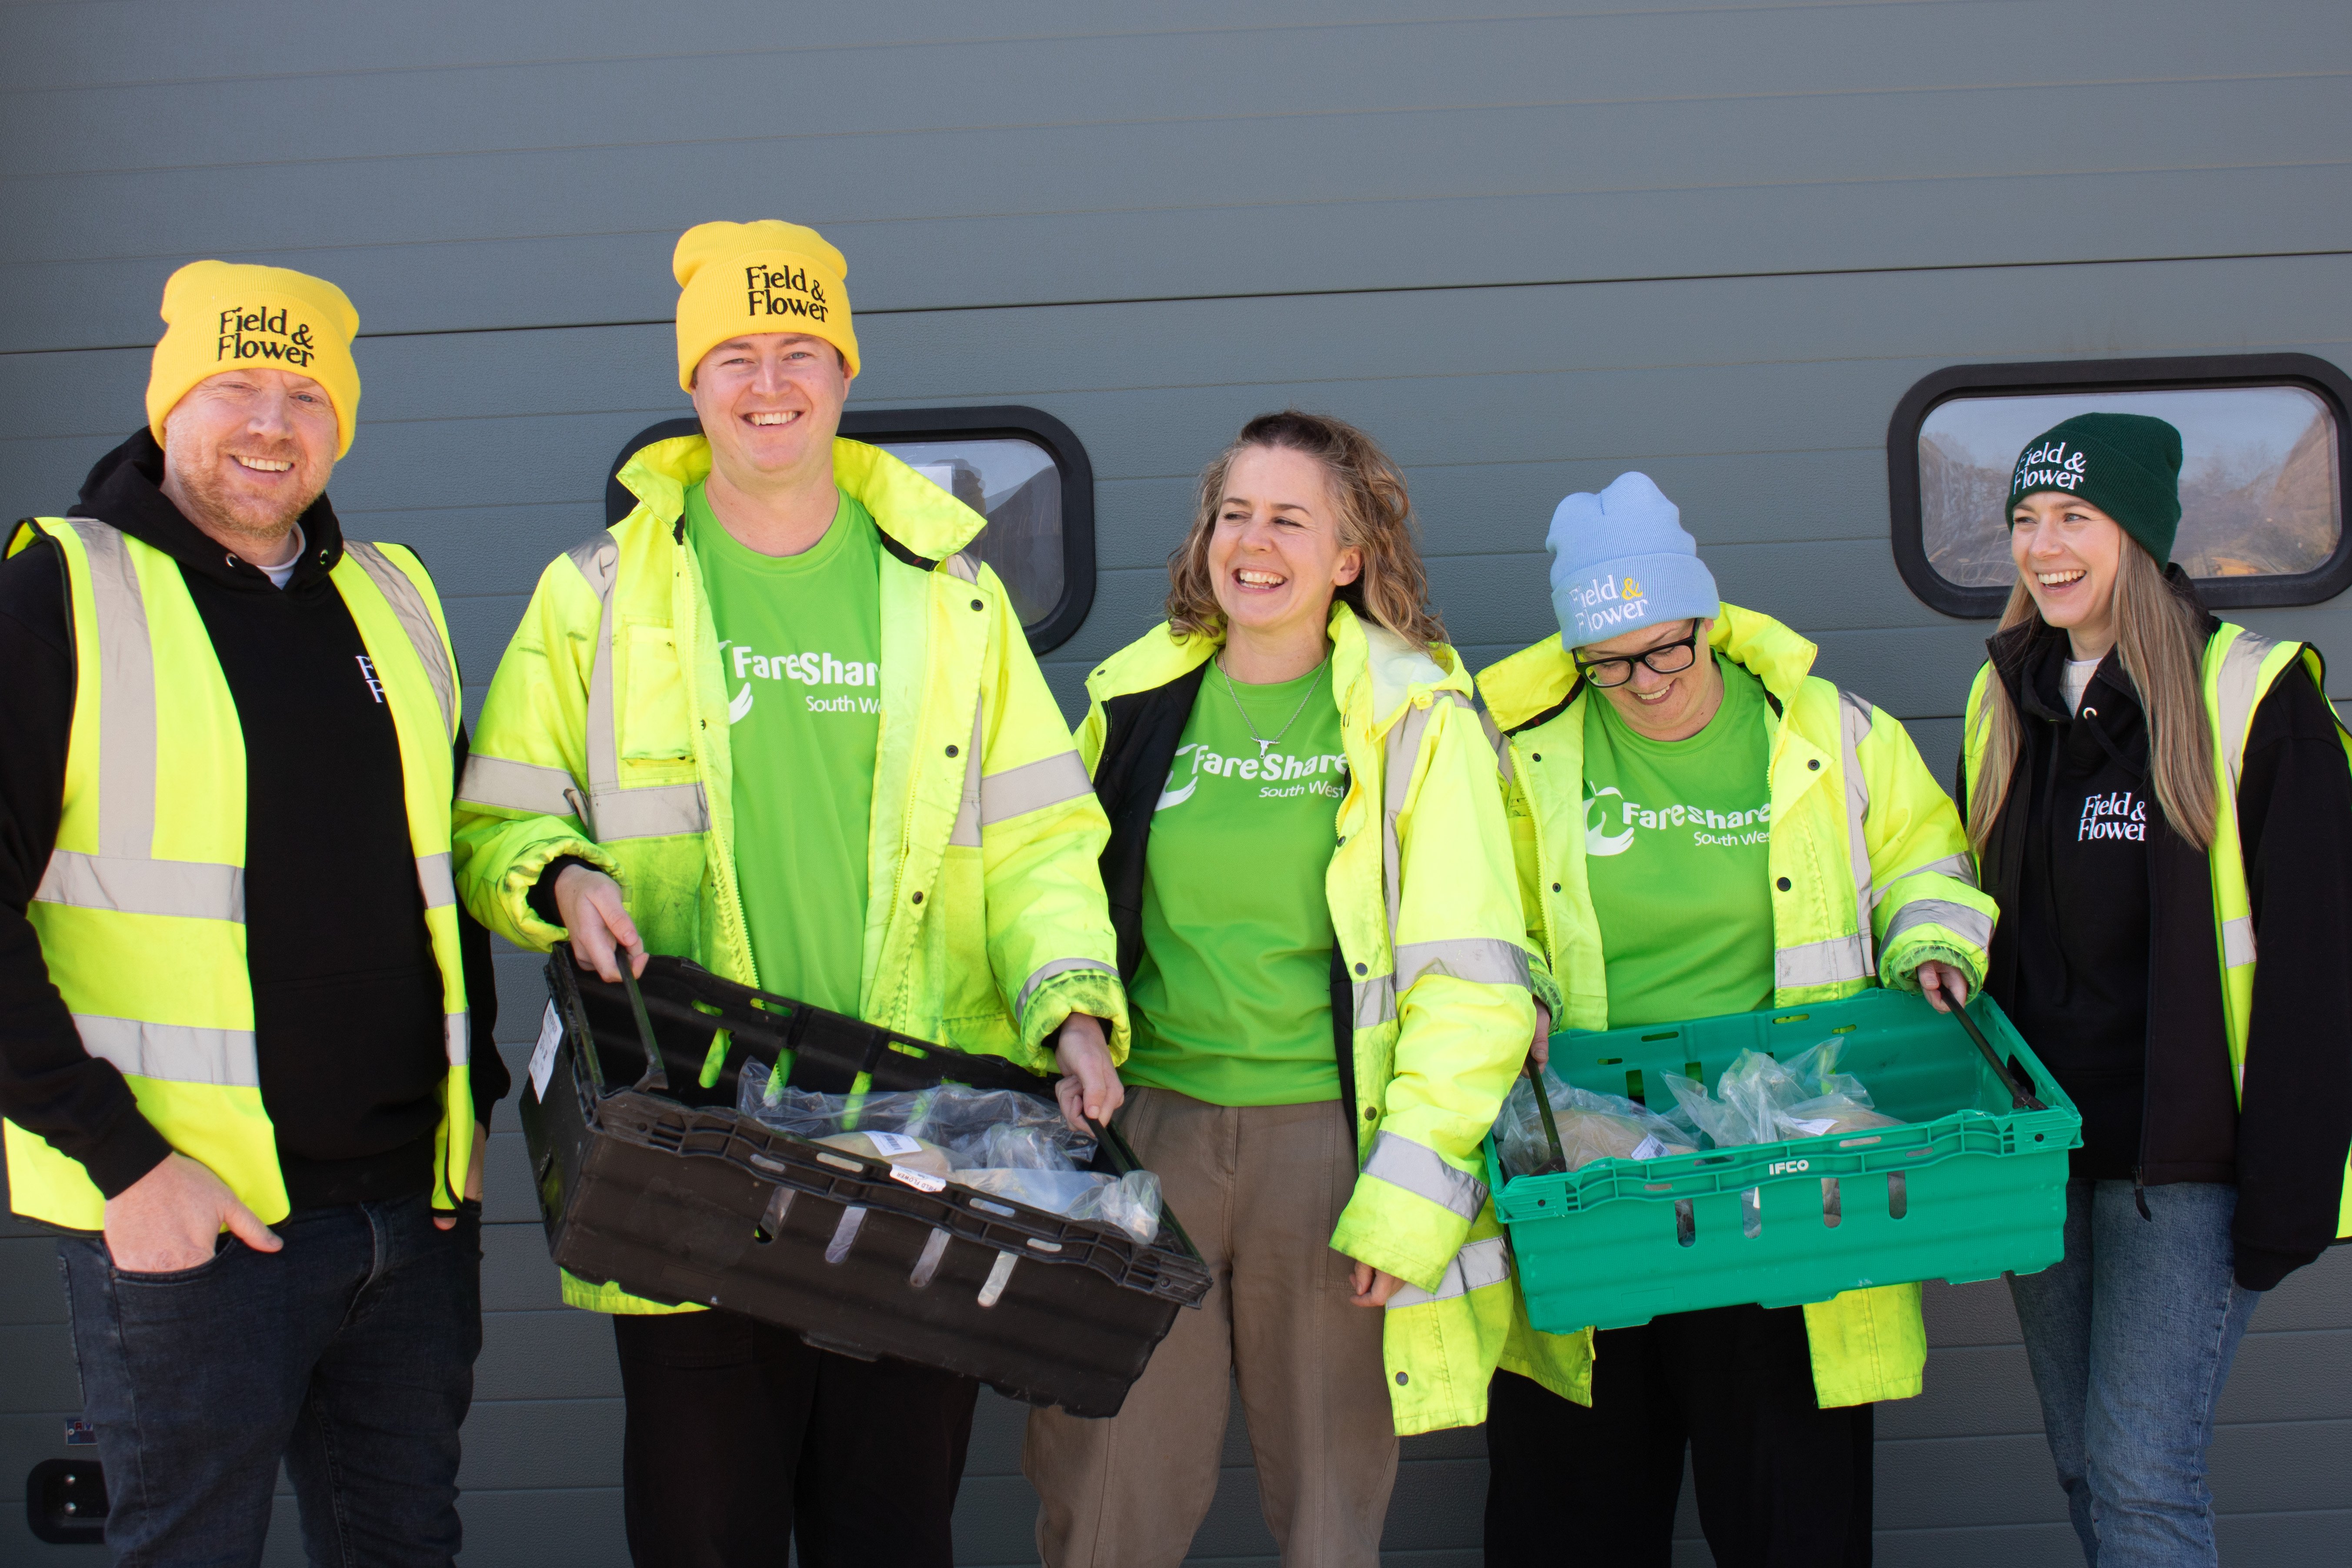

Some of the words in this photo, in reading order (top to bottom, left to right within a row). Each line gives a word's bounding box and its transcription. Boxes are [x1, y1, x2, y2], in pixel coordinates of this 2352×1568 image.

[745, 264, 808, 293] Field
[811, 279, 826, 304] &
[747, 289, 828, 323] Flower
[220, 306, 287, 336] Field
[291, 324, 314, 350] &
[217, 333, 314, 367] Flower
[2016, 442, 2066, 473] Field
[2064, 452, 2087, 473] &
[2013, 466, 2084, 495] Flower
[1569, 574, 1618, 610] Field
[1621, 577, 1643, 601] &
[1575, 598, 1648, 633] Flower
[732, 646, 881, 686] FareShar
[805, 695, 855, 712] South
[1191, 745, 1349, 781] FareShare
[1259, 784, 1304, 798] South
[1309, 780, 1344, 798] West
[1622, 802, 1771, 830] FareShare
[2081, 792, 2132, 818] Field
[2130, 801, 2147, 822] &
[1693, 831, 1738, 846] South
[2078, 816, 2147, 841] Flower
[897, 1172, 921, 1185] FLOWER
[1768, 1159, 1809, 1176] IFCO
